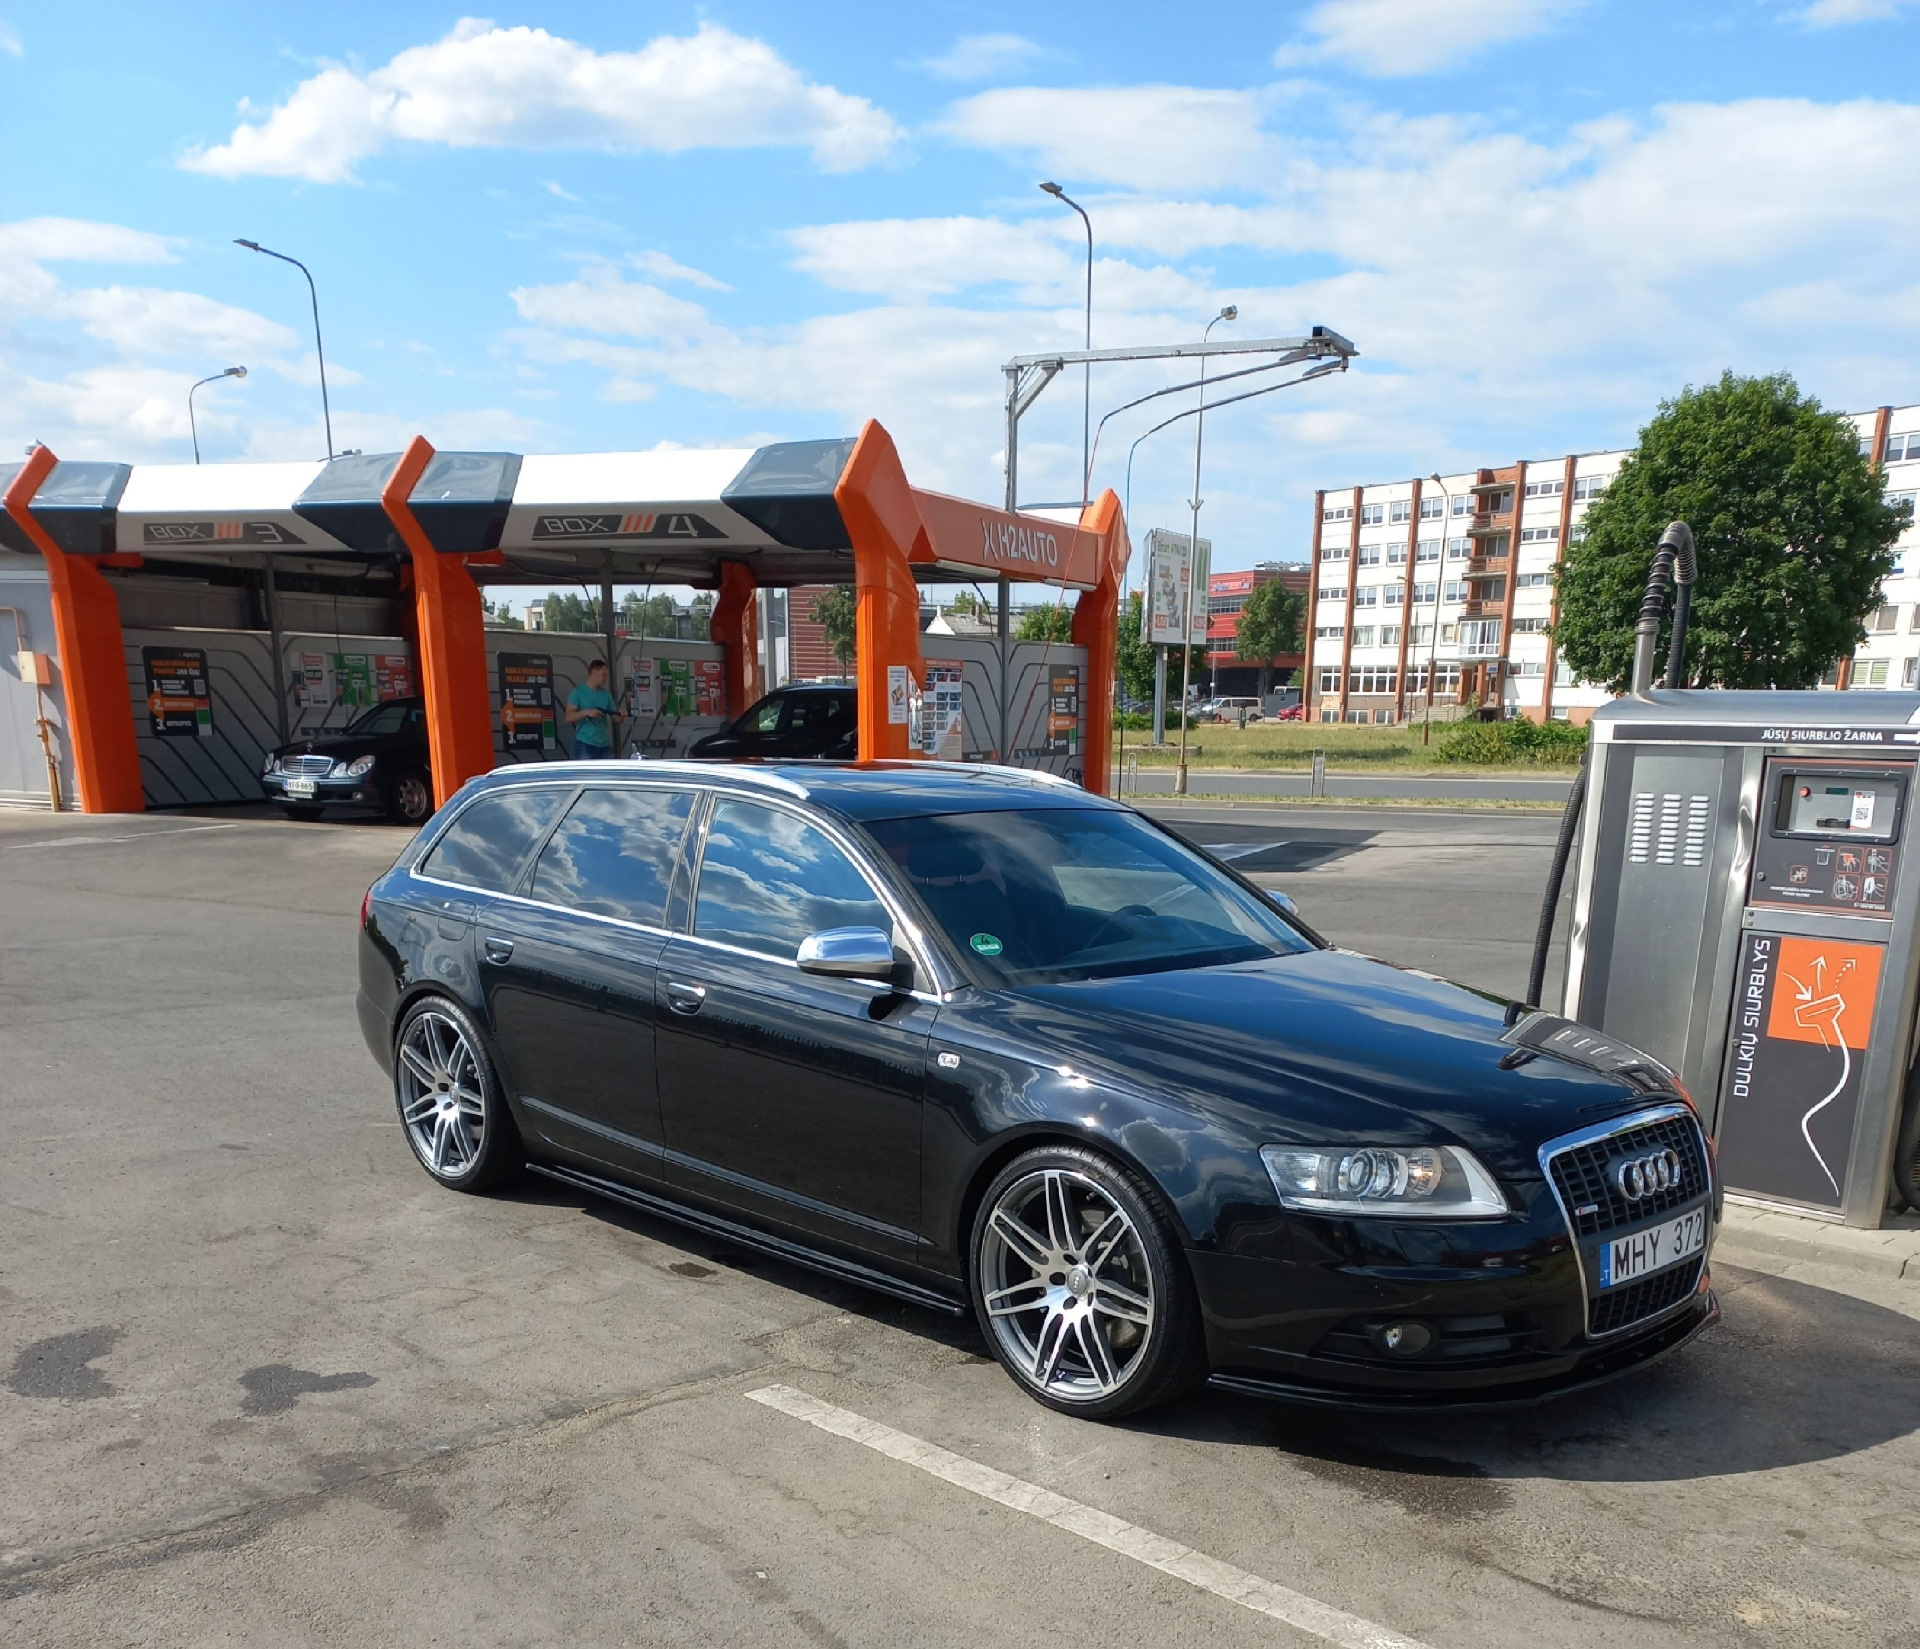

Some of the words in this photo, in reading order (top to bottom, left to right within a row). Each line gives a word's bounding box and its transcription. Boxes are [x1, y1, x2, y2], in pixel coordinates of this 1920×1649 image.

[149, 525, 206, 539] BOX
[251, 523, 283, 543] 3
[543, 517, 609, 533] BOX
[667, 515, 699, 537] 4
[997, 522, 1058, 567] H2AUTO
[1761, 728, 1789, 742] JŪSŲ
[1791, 730, 1842, 741] SIURBLIO
[1844, 729, 1883, 741] ŽARNA
[1743, 938, 1771, 1028] SIURBLYS
[1733, 1033, 1759, 1098] DULKIŲ
[1614, 1229, 1661, 1280] MHY
[1673, 1212, 1702, 1255] 372
